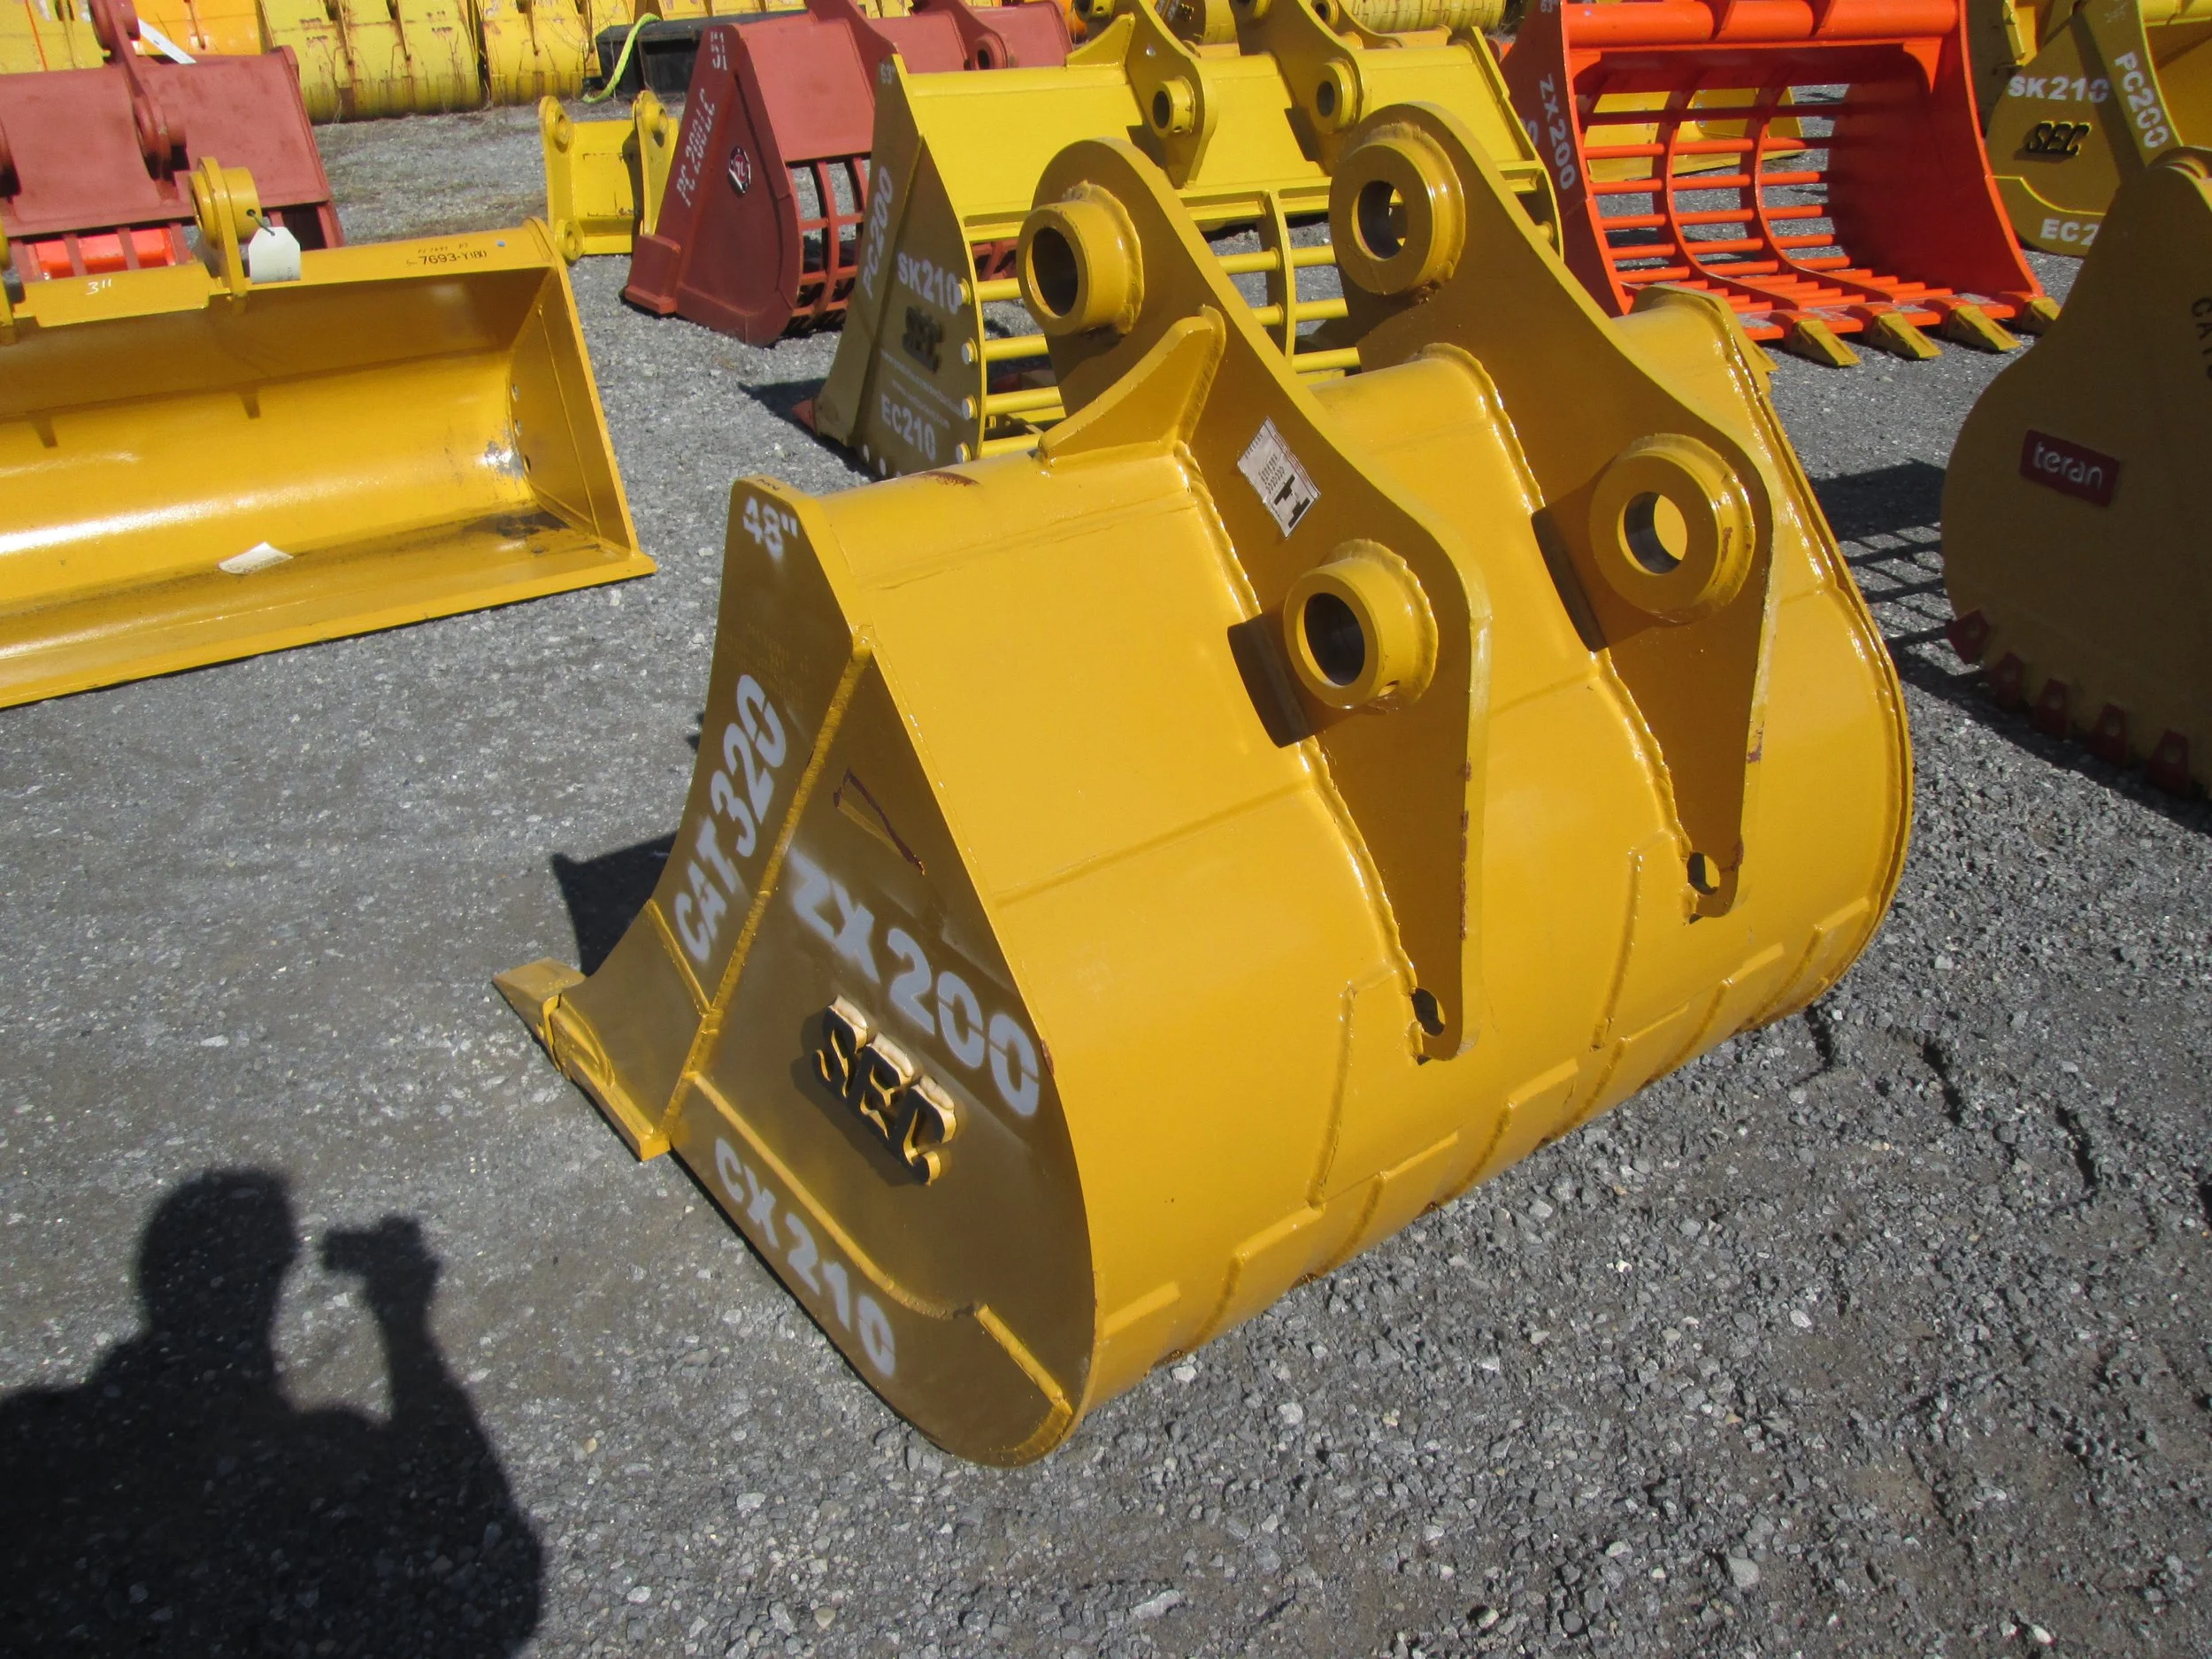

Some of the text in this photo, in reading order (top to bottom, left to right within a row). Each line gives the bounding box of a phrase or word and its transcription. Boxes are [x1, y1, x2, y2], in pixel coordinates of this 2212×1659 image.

[1540, 73, 1576, 190] ZX200
[2008, 75, 2110, 104] SK210
[2115, 51, 2170, 150] PC200
[863, 165, 893, 301] PC200
[897, 250, 964, 316] SK210
[880, 392, 937, 462] EC210
[2032, 441, 2103, 491] teran
[742, 495, 799, 563] 48"
[790, 846, 1041, 1118] ZX200
[715, 1138, 895, 1378] CX210
